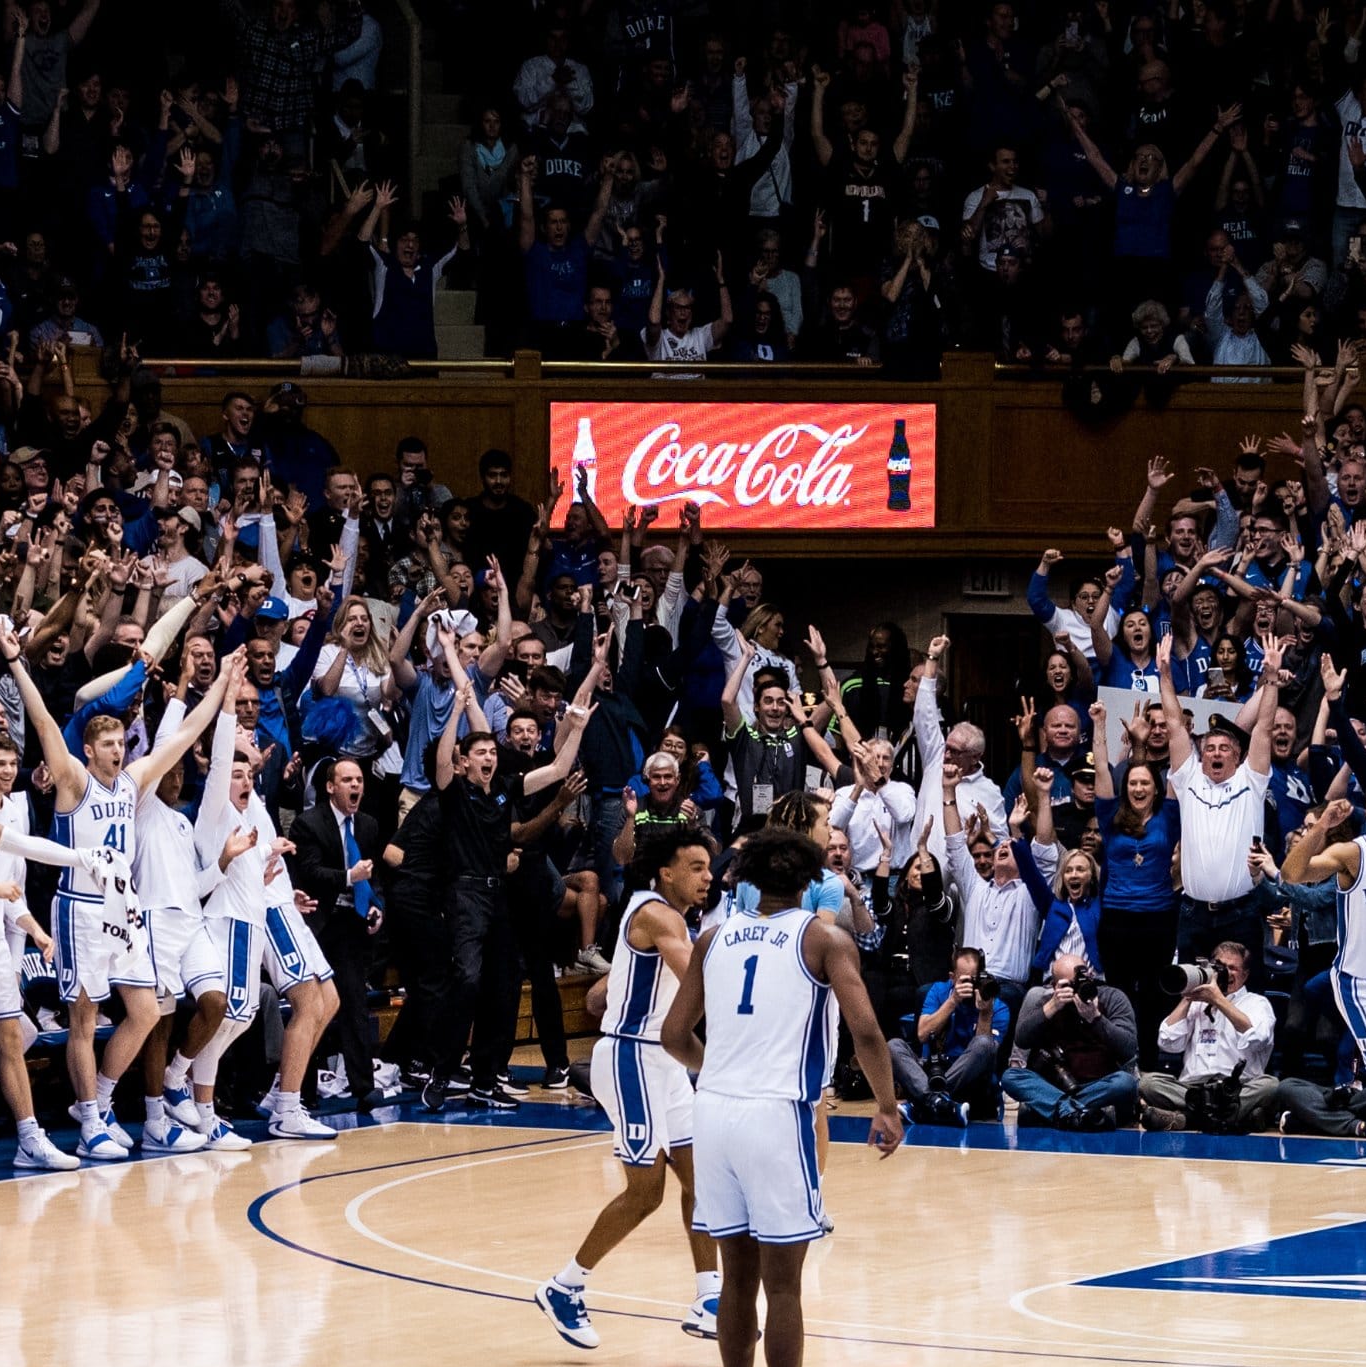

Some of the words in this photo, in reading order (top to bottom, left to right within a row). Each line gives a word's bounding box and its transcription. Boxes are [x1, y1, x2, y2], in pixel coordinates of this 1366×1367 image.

[625, 15, 668, 39] DUKE
[545, 158, 583, 177] DUKE
[861, 199, 870, 223] 1
[622, 422, 869, 509] Coca-Cola
[92, 799, 135, 821] DUKE
[103, 832, 126, 854] 41
[725, 926, 768, 948] CAREY
[773, 930, 789, 949] JR
[738, 954, 759, 1015] 1
